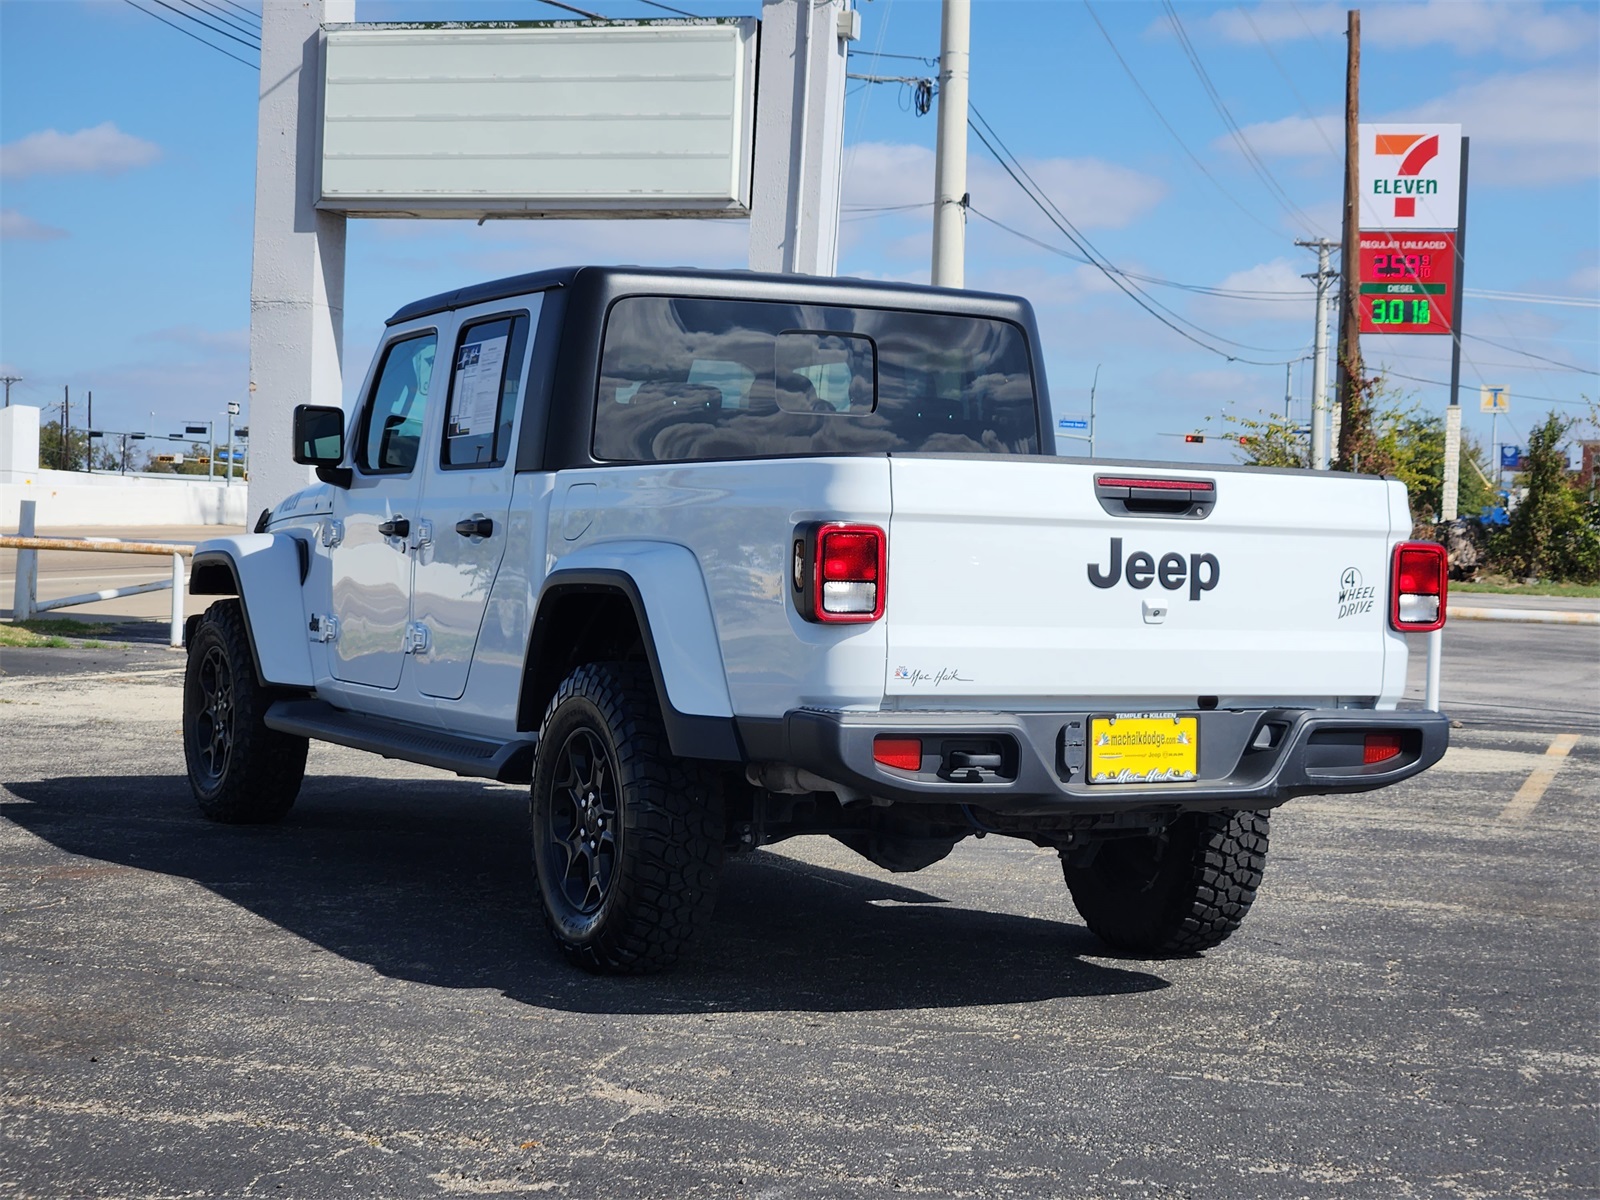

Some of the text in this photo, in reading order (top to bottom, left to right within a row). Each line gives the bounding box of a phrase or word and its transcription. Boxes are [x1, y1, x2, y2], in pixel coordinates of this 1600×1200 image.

[1360, 240, 1447, 250] REGULAR UNLEADED
[1387, 284, 1415, 293] DIESEL
[1087, 537, 1220, 602] Jeep
[1344, 570, 1355, 587] 4
[1338, 586, 1375, 604] WHEEL
[1338, 600, 1374, 619] DRIVE
[910, 667, 963, 687] Mac Haik
[1110, 731, 1176, 747] machaikdodge.com
[1115, 767, 1174, 783] Mac Haik
